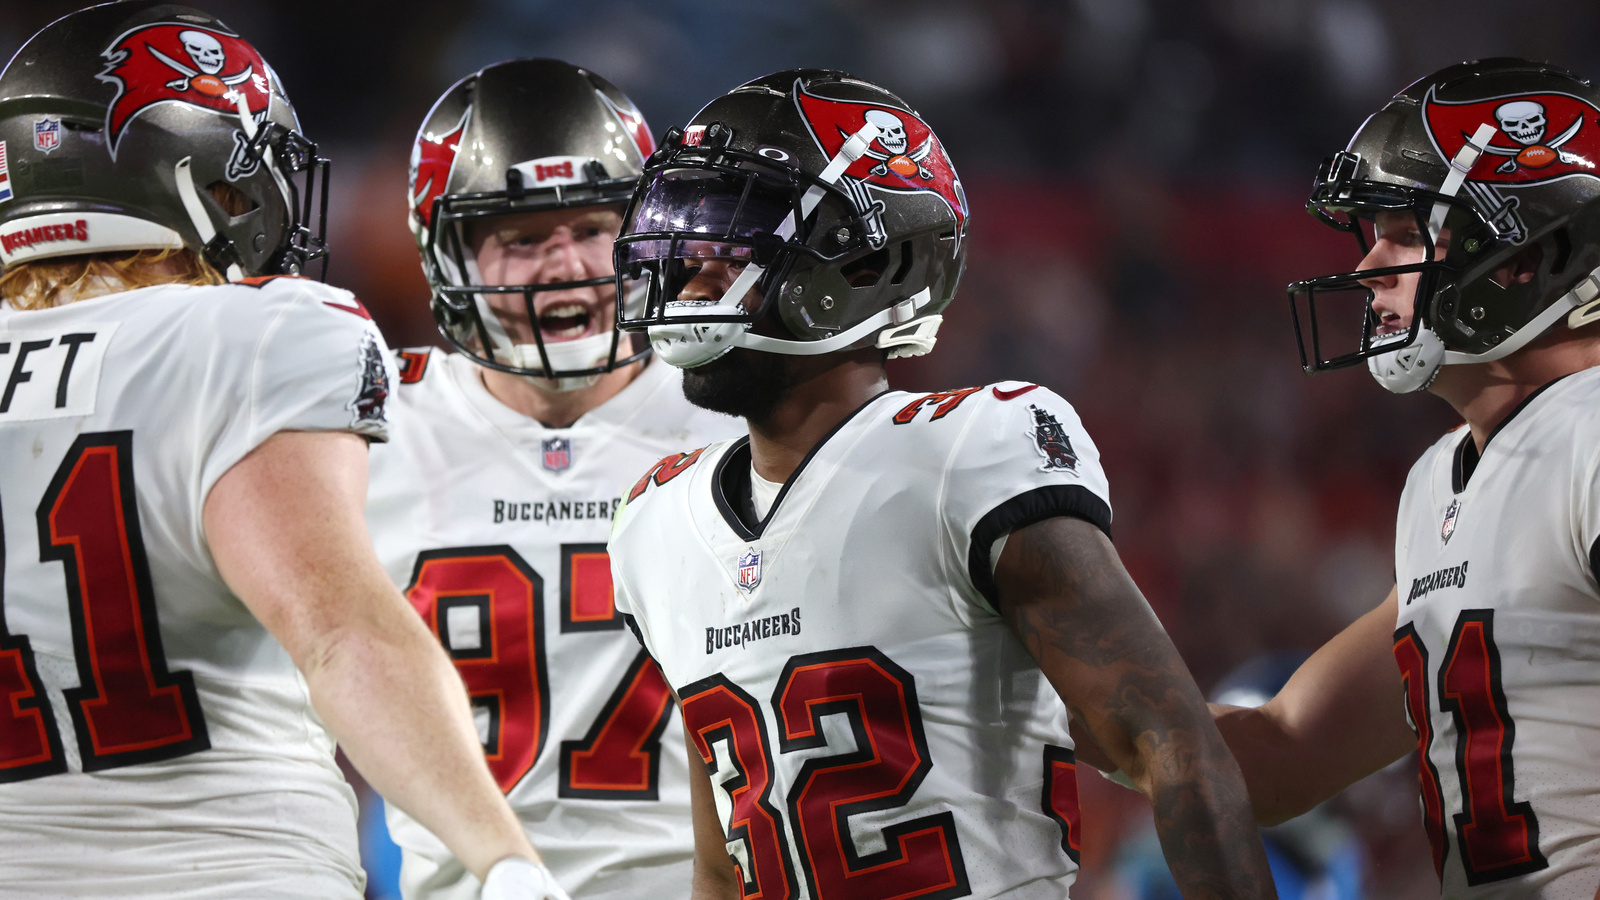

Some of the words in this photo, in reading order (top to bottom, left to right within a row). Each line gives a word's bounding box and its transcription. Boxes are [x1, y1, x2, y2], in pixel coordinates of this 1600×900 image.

[37, 132, 58, 148] NFL
[544, 451, 569, 469] NFL
[493, 498, 621, 526] BUCCANEERS
[740, 567, 757, 585] NFL
[1406, 560, 1469, 606] BUCCANEERS
[705, 607, 801, 654] BUCCANEERS
[403, 543, 674, 801] 97
[678, 646, 972, 900] 32
